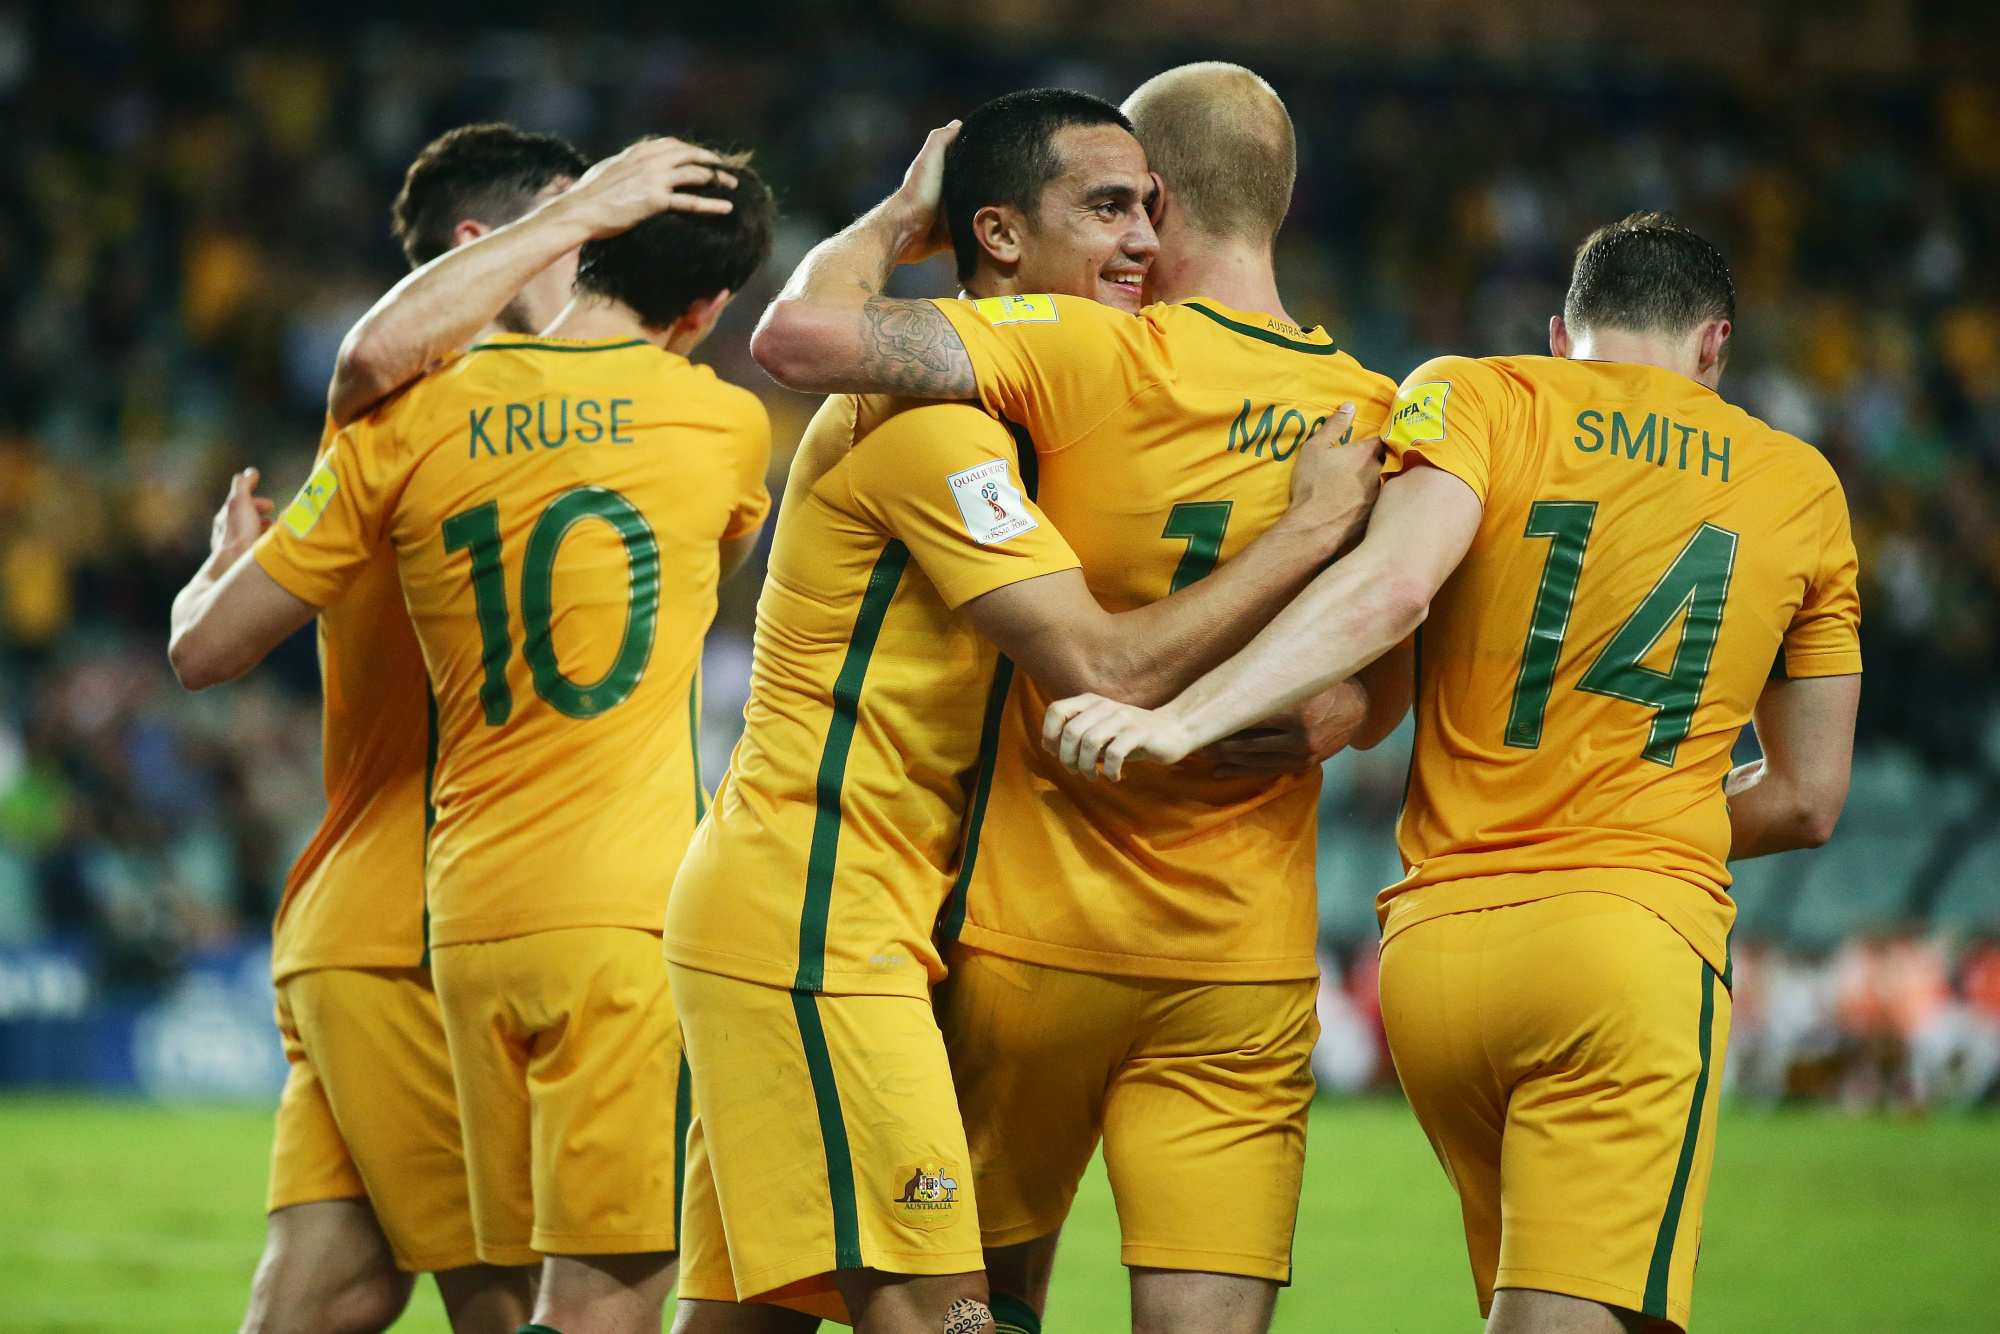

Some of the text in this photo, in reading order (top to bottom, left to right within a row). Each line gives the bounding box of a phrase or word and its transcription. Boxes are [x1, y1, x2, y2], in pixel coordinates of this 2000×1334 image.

[469, 399, 634, 459] KRUSE
[1393, 402, 1420, 425] FIFA
[1573, 409, 1731, 482] SMITH
[441, 485, 660, 726] 10
[1503, 500, 1740, 768] 14
[904, 1202, 953, 1210] AUSTRALIA
